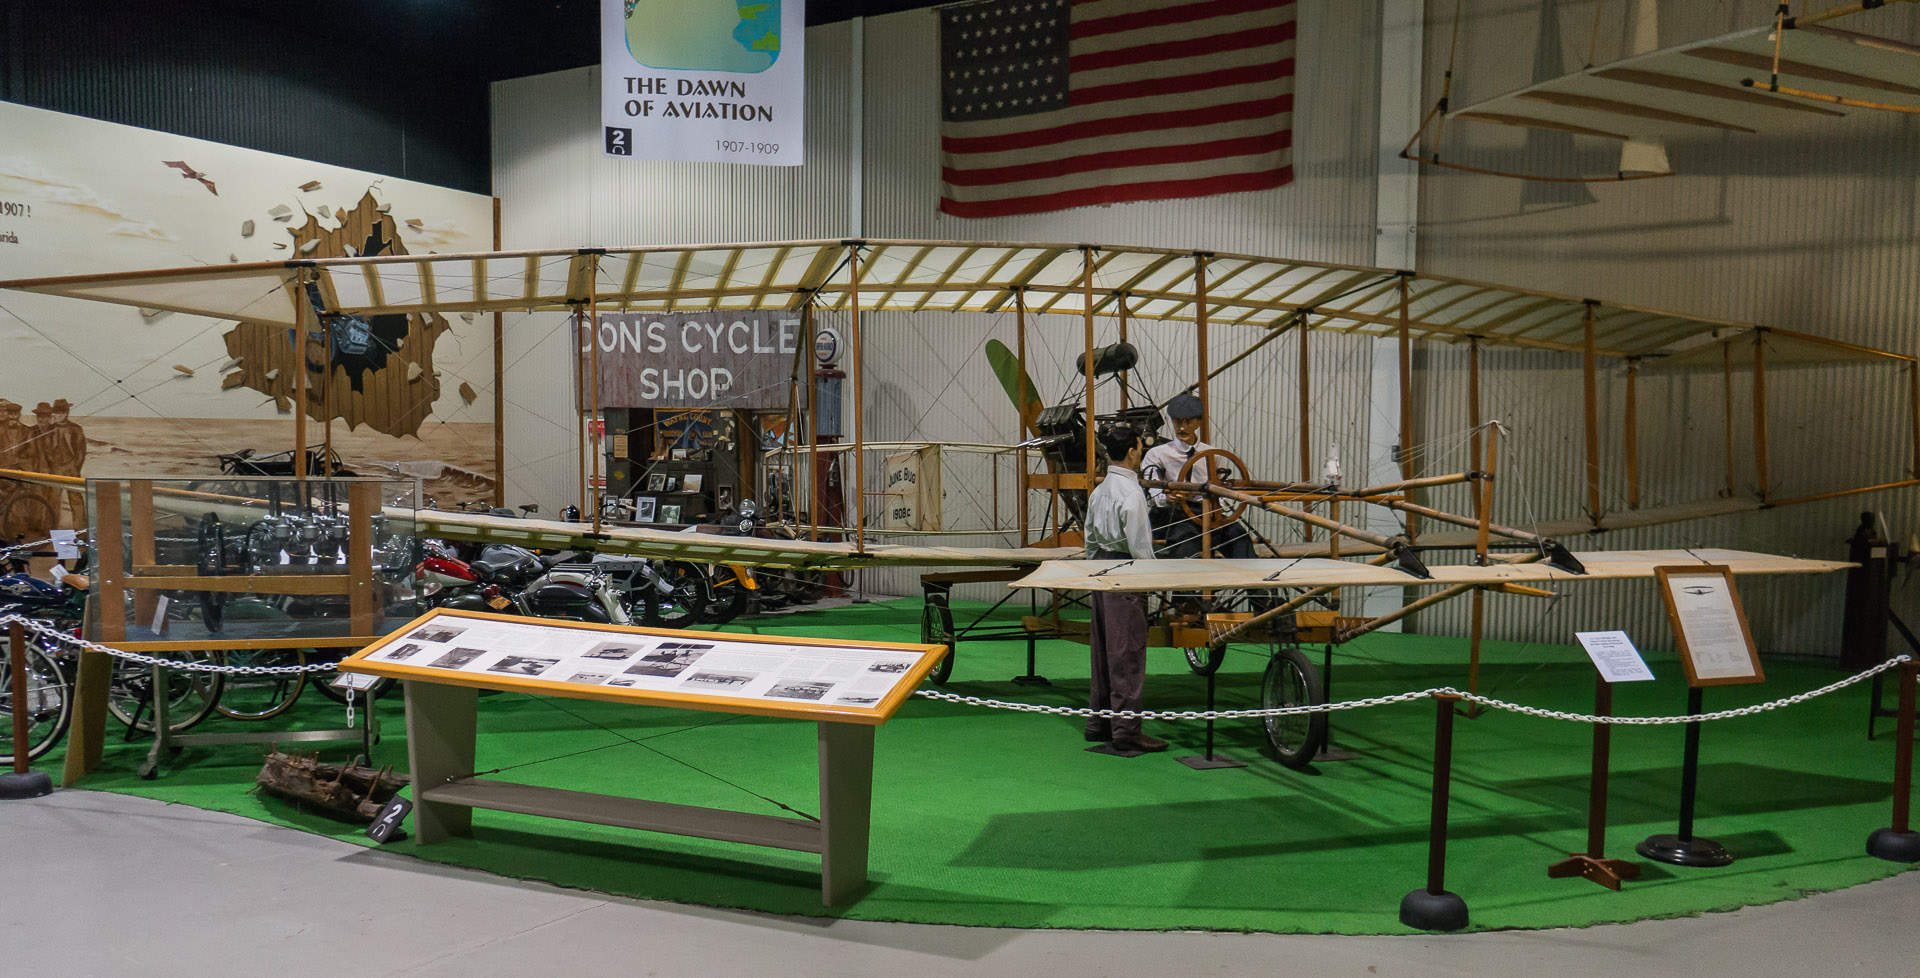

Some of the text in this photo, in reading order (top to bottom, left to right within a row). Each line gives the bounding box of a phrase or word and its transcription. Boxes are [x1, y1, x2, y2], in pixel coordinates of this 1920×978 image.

[624, 77, 745, 98] THE DAWN
[624, 100, 773, 123] OF AVIATION
[612, 130, 625, 145] 2
[715, 140, 779, 155] 1907-1909
[682, 319, 801, 354] CYCLE
[640, 367, 733, 400] SHOP
[888, 467, 916, 487] JUNE BUG
[383, 803, 403, 824] 2
